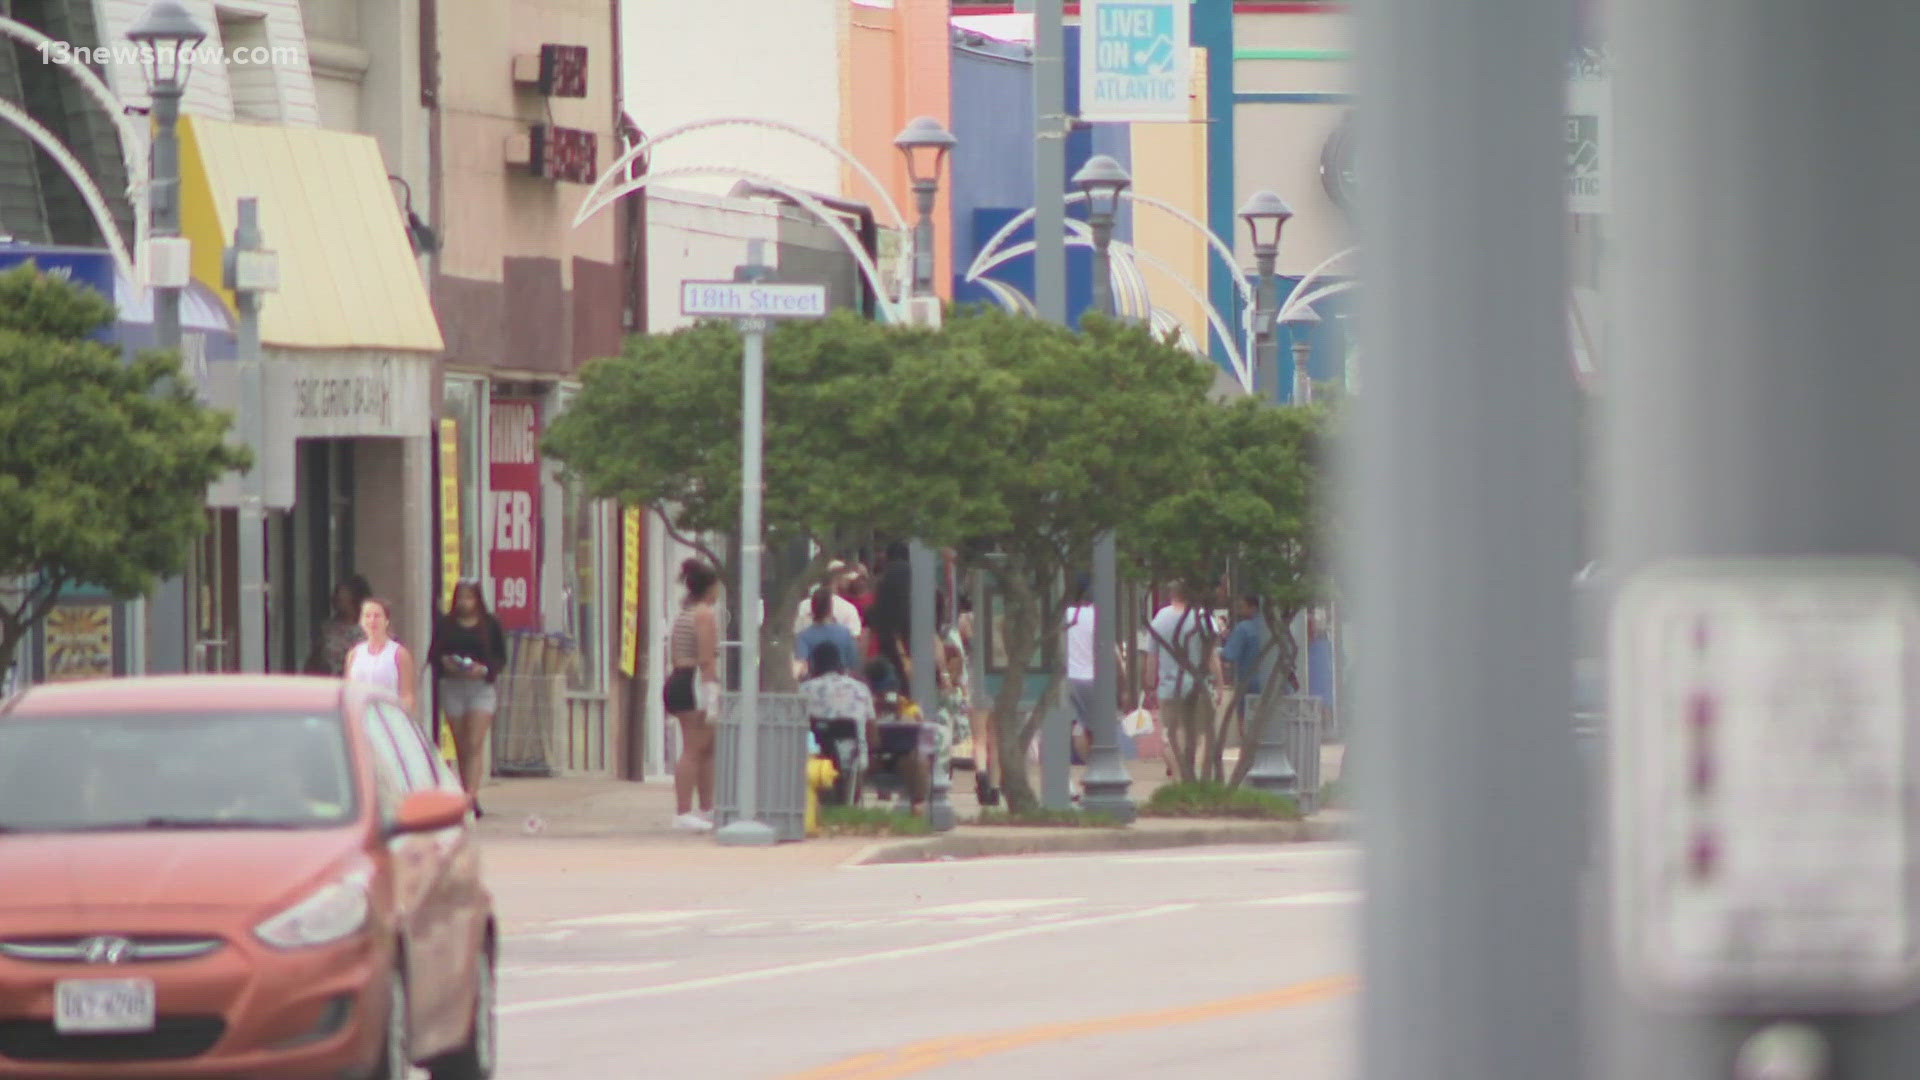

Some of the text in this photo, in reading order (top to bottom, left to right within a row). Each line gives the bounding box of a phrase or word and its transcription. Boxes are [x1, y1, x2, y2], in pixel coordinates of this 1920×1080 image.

[1100, 8, 1153, 37] LIVE!
[1100, 41, 1128, 70] ON
[1094, 78, 1176, 100] ATLANTIC
[690, 286, 818, 310] 18th Street
